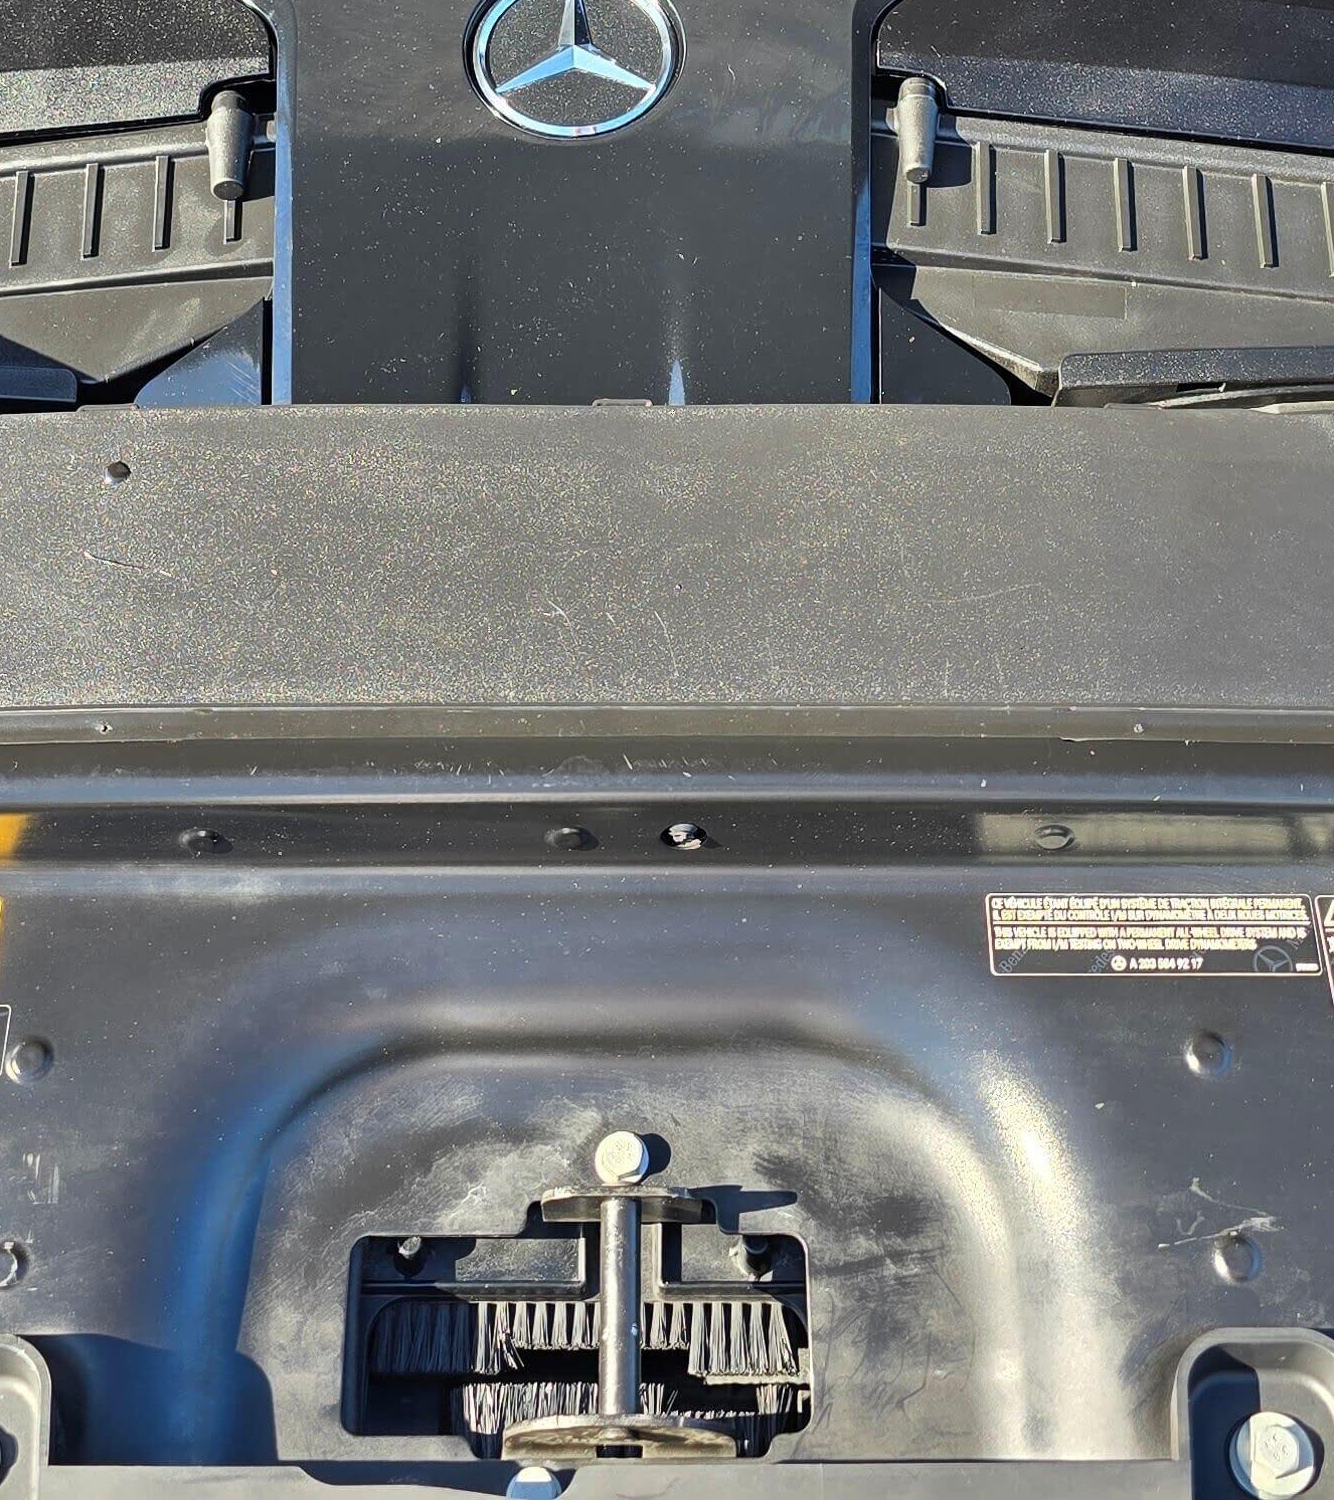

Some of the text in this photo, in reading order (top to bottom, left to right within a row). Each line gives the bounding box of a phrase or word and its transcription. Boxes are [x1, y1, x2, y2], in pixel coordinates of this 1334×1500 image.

[992, 897, 1003, 910] CE
[1004, 896, 1042, 910] VÉHICULE
[1043, 896, 1068, 910] ÉTANT
[1069, 896, 1098, 910] ÉQUIPÉ
[1121, 896, 1157, 910] SYSTÈME
[1158, 897, 1170, 910] DE
[1171, 897, 1209, 910] TRACTION
[1210, 896, 1253, 910] INTÉGRALE
[993, 909, 1001, 921] IL
[1001, 909, 1016, 921] EST
[1017, 909, 1053, 921] EXEMPTÉ
[1054, 909, 1066, 921] DU
[1128, 909, 1144, 921] SUR
[1214, 909, 1236, 921] DEUX
[1237, 909, 1264, 921] ROUES
[994, 926, 1013, 938] THIS
[1013, 926, 1047, 938] VEHICLE
[1047, 926, 1056, 938] IS
[1057, 926, 1096, 938] EQUIPPED
[1097, 926, 1118, 938] WITH
[1126, 926, 1175, 938] PERMANENT
[1220, 926, 1244, 938] DRIVE
[1245, 926, 1277, 938] SYSTEM
[1278, 926, 1296, 938] AND
[1297, 926, 1307, 938] IS
[995, 938, 1026, 950] EXEMPT
[1027, 938, 1051, 950] FROM
[1069, 938, 1102, 950] TESTING
[1103, 938, 1116, 950] ON
[1165, 938, 1189, 950] DRIVE
[1129, 957, 1138, 970] A
[1177, 957, 1190, 970] 92
[1191, 957, 1203, 970] 17
